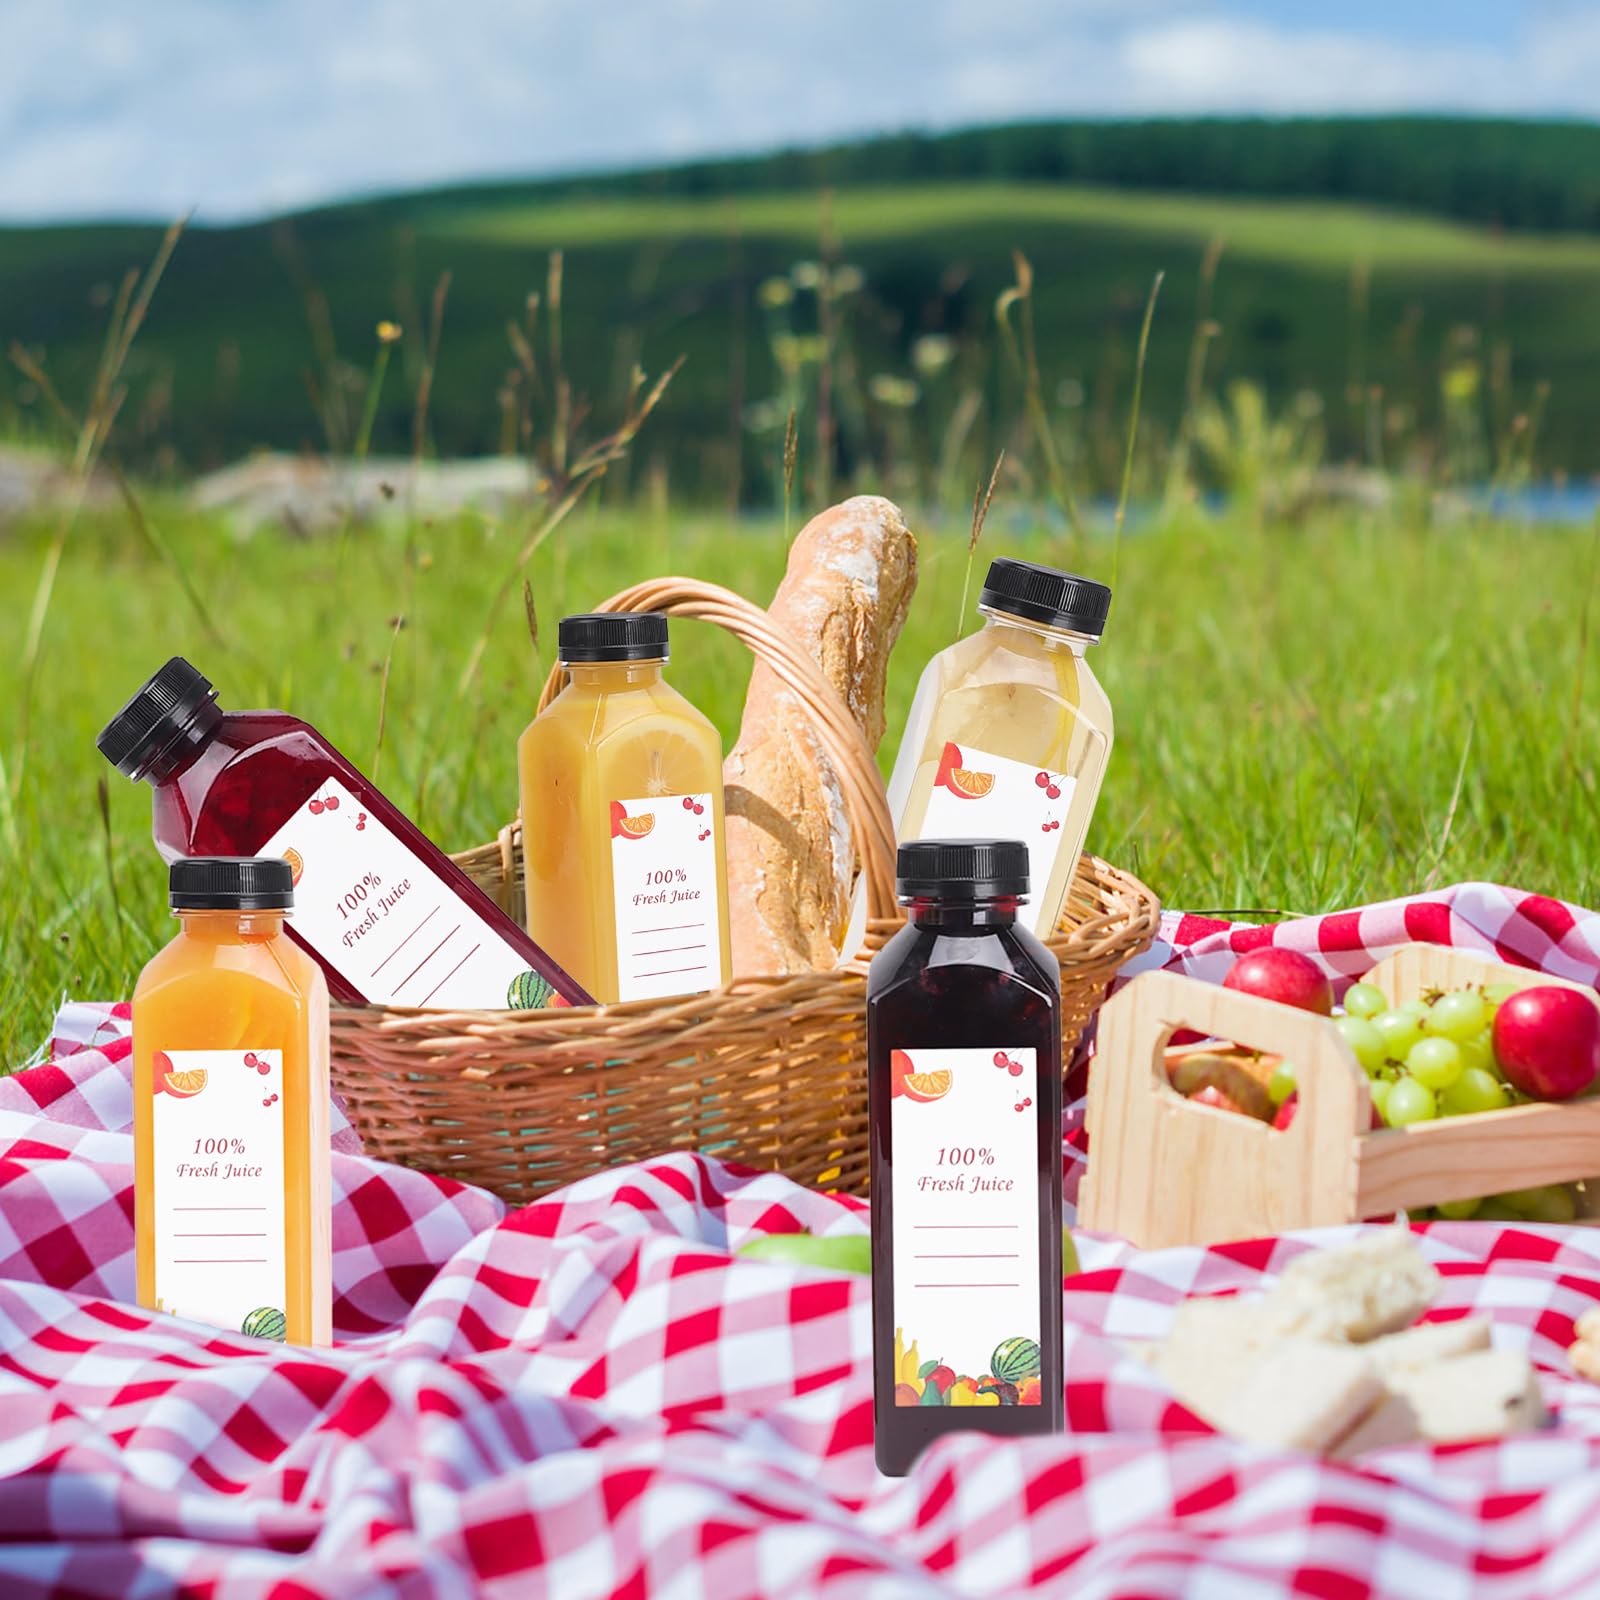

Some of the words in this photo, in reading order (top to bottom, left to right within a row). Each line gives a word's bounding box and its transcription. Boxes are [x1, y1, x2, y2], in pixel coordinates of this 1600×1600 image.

[646, 868, 687, 886] 100%
[336, 871, 382, 921] 100%
[633, 889, 667, 906] Fresh
[669, 889, 701, 905] Juice
[342, 907, 380, 948] Fresh
[377, 878, 411, 917] Juice
[193, 1138, 246, 1155] 100%
[937, 1147, 996, 1166] 100%
[176, 1163, 218, 1178] Fresh
[224, 1163, 263, 1179] Juice
[917, 1174, 966, 1192] Fresh
[971, 1176, 1014, 1193] Juice
